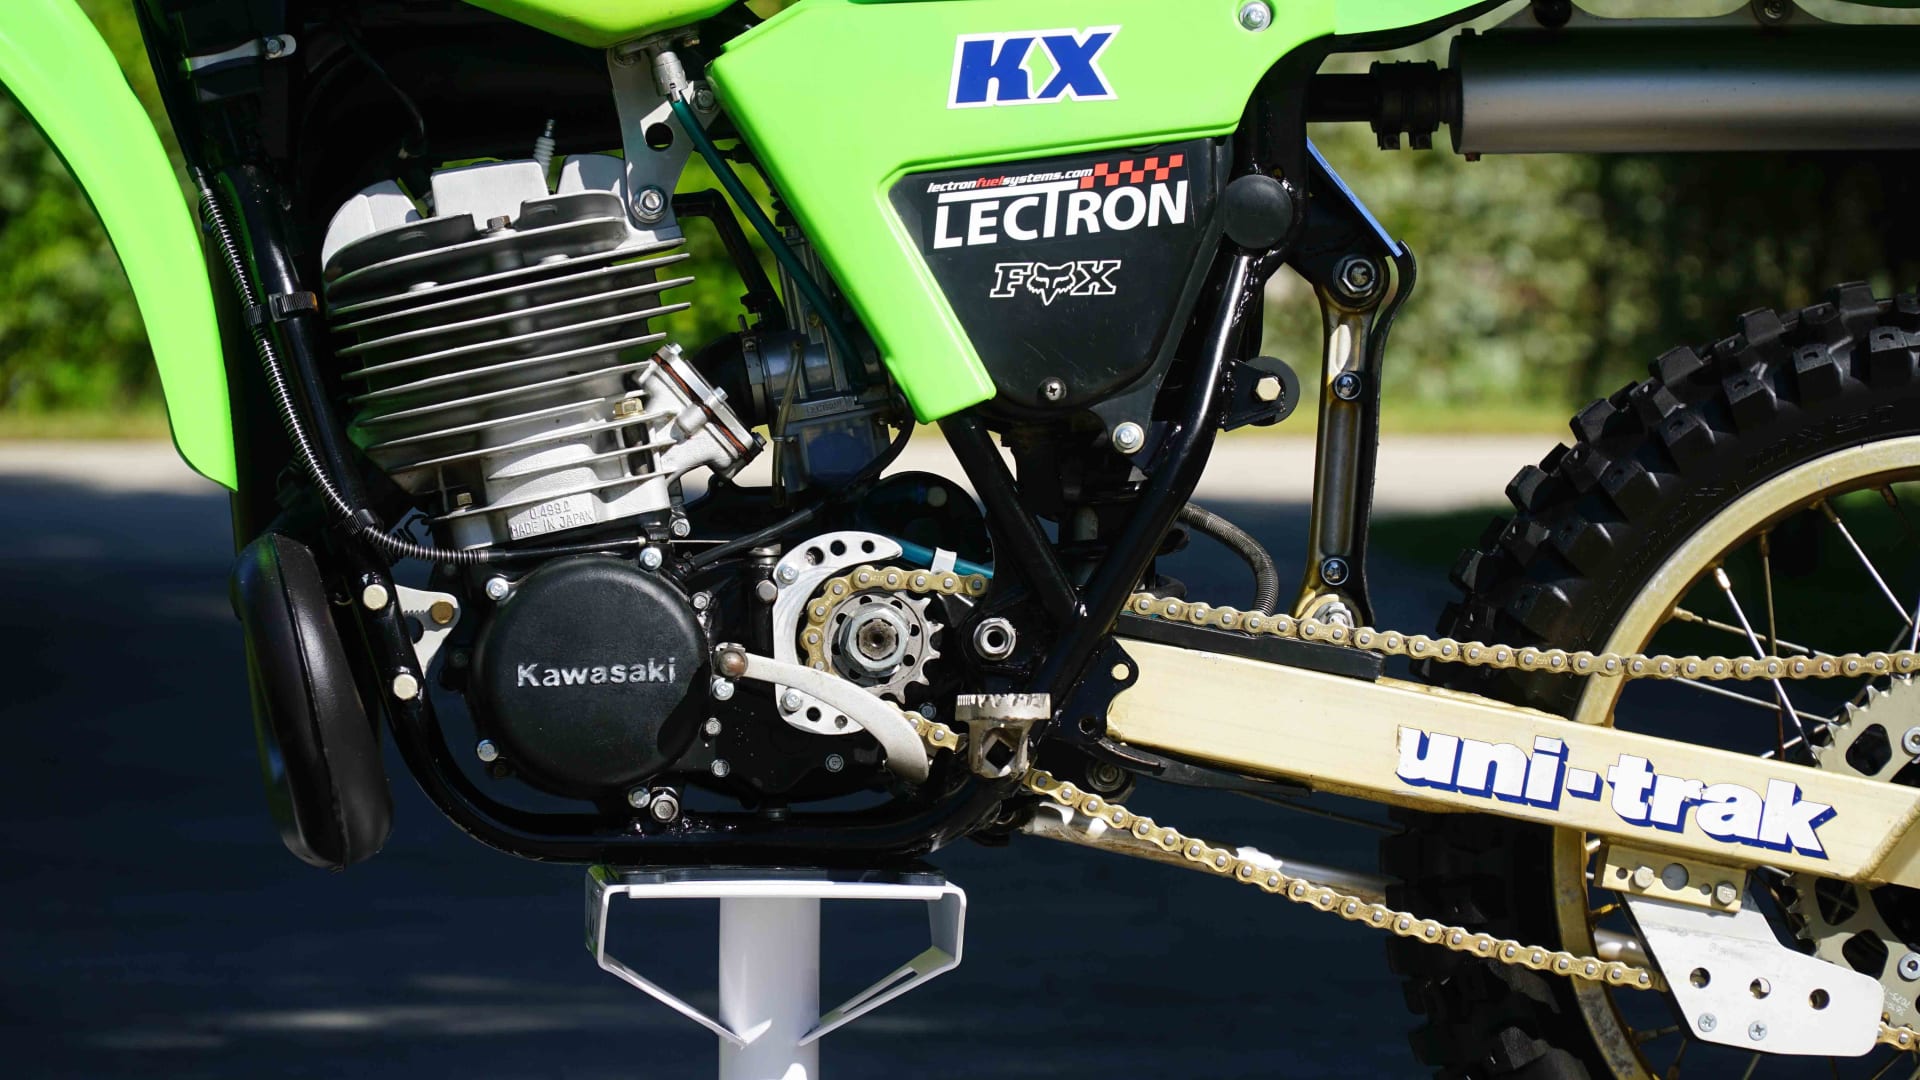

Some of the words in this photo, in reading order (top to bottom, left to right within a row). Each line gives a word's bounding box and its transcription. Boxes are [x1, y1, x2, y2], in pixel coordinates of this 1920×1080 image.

[949, 26, 1119, 108] KX
[927, 168, 1093, 193] lectronfuelsystems.com
[933, 180, 1188, 249] LECTRON
[511, 521, 538, 538] MADE
[543, 517, 556, 533] IN
[559, 510, 594, 530] JAPAN
[517, 657, 676, 687] Kawasaki
[1396, 725, 1838, 860] uni-trak
